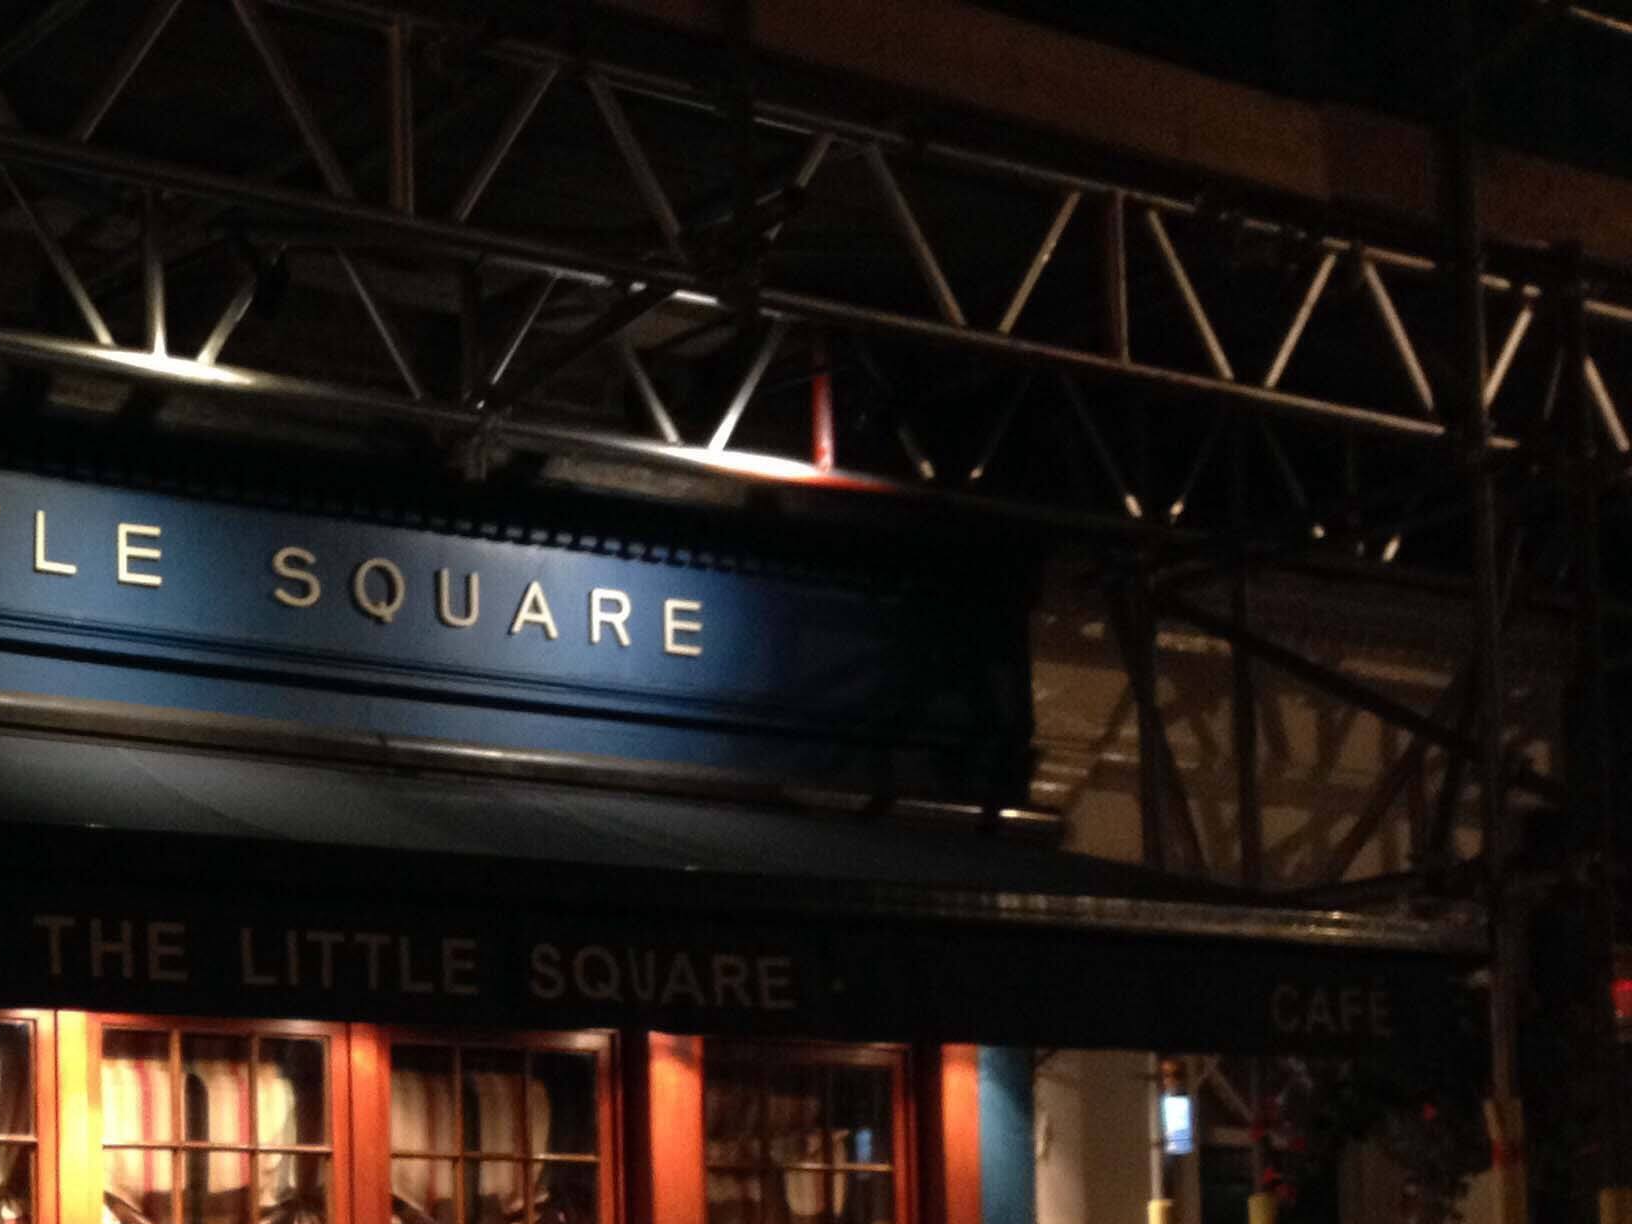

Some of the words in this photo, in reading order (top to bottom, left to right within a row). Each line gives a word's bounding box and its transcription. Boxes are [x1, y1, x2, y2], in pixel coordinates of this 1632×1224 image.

[271, 545, 705, 658] SQUARE
[32, 912, 191, 984] THE
[239, 925, 482, 998] LITTLE
[527, 941, 801, 1009] SQUARE
